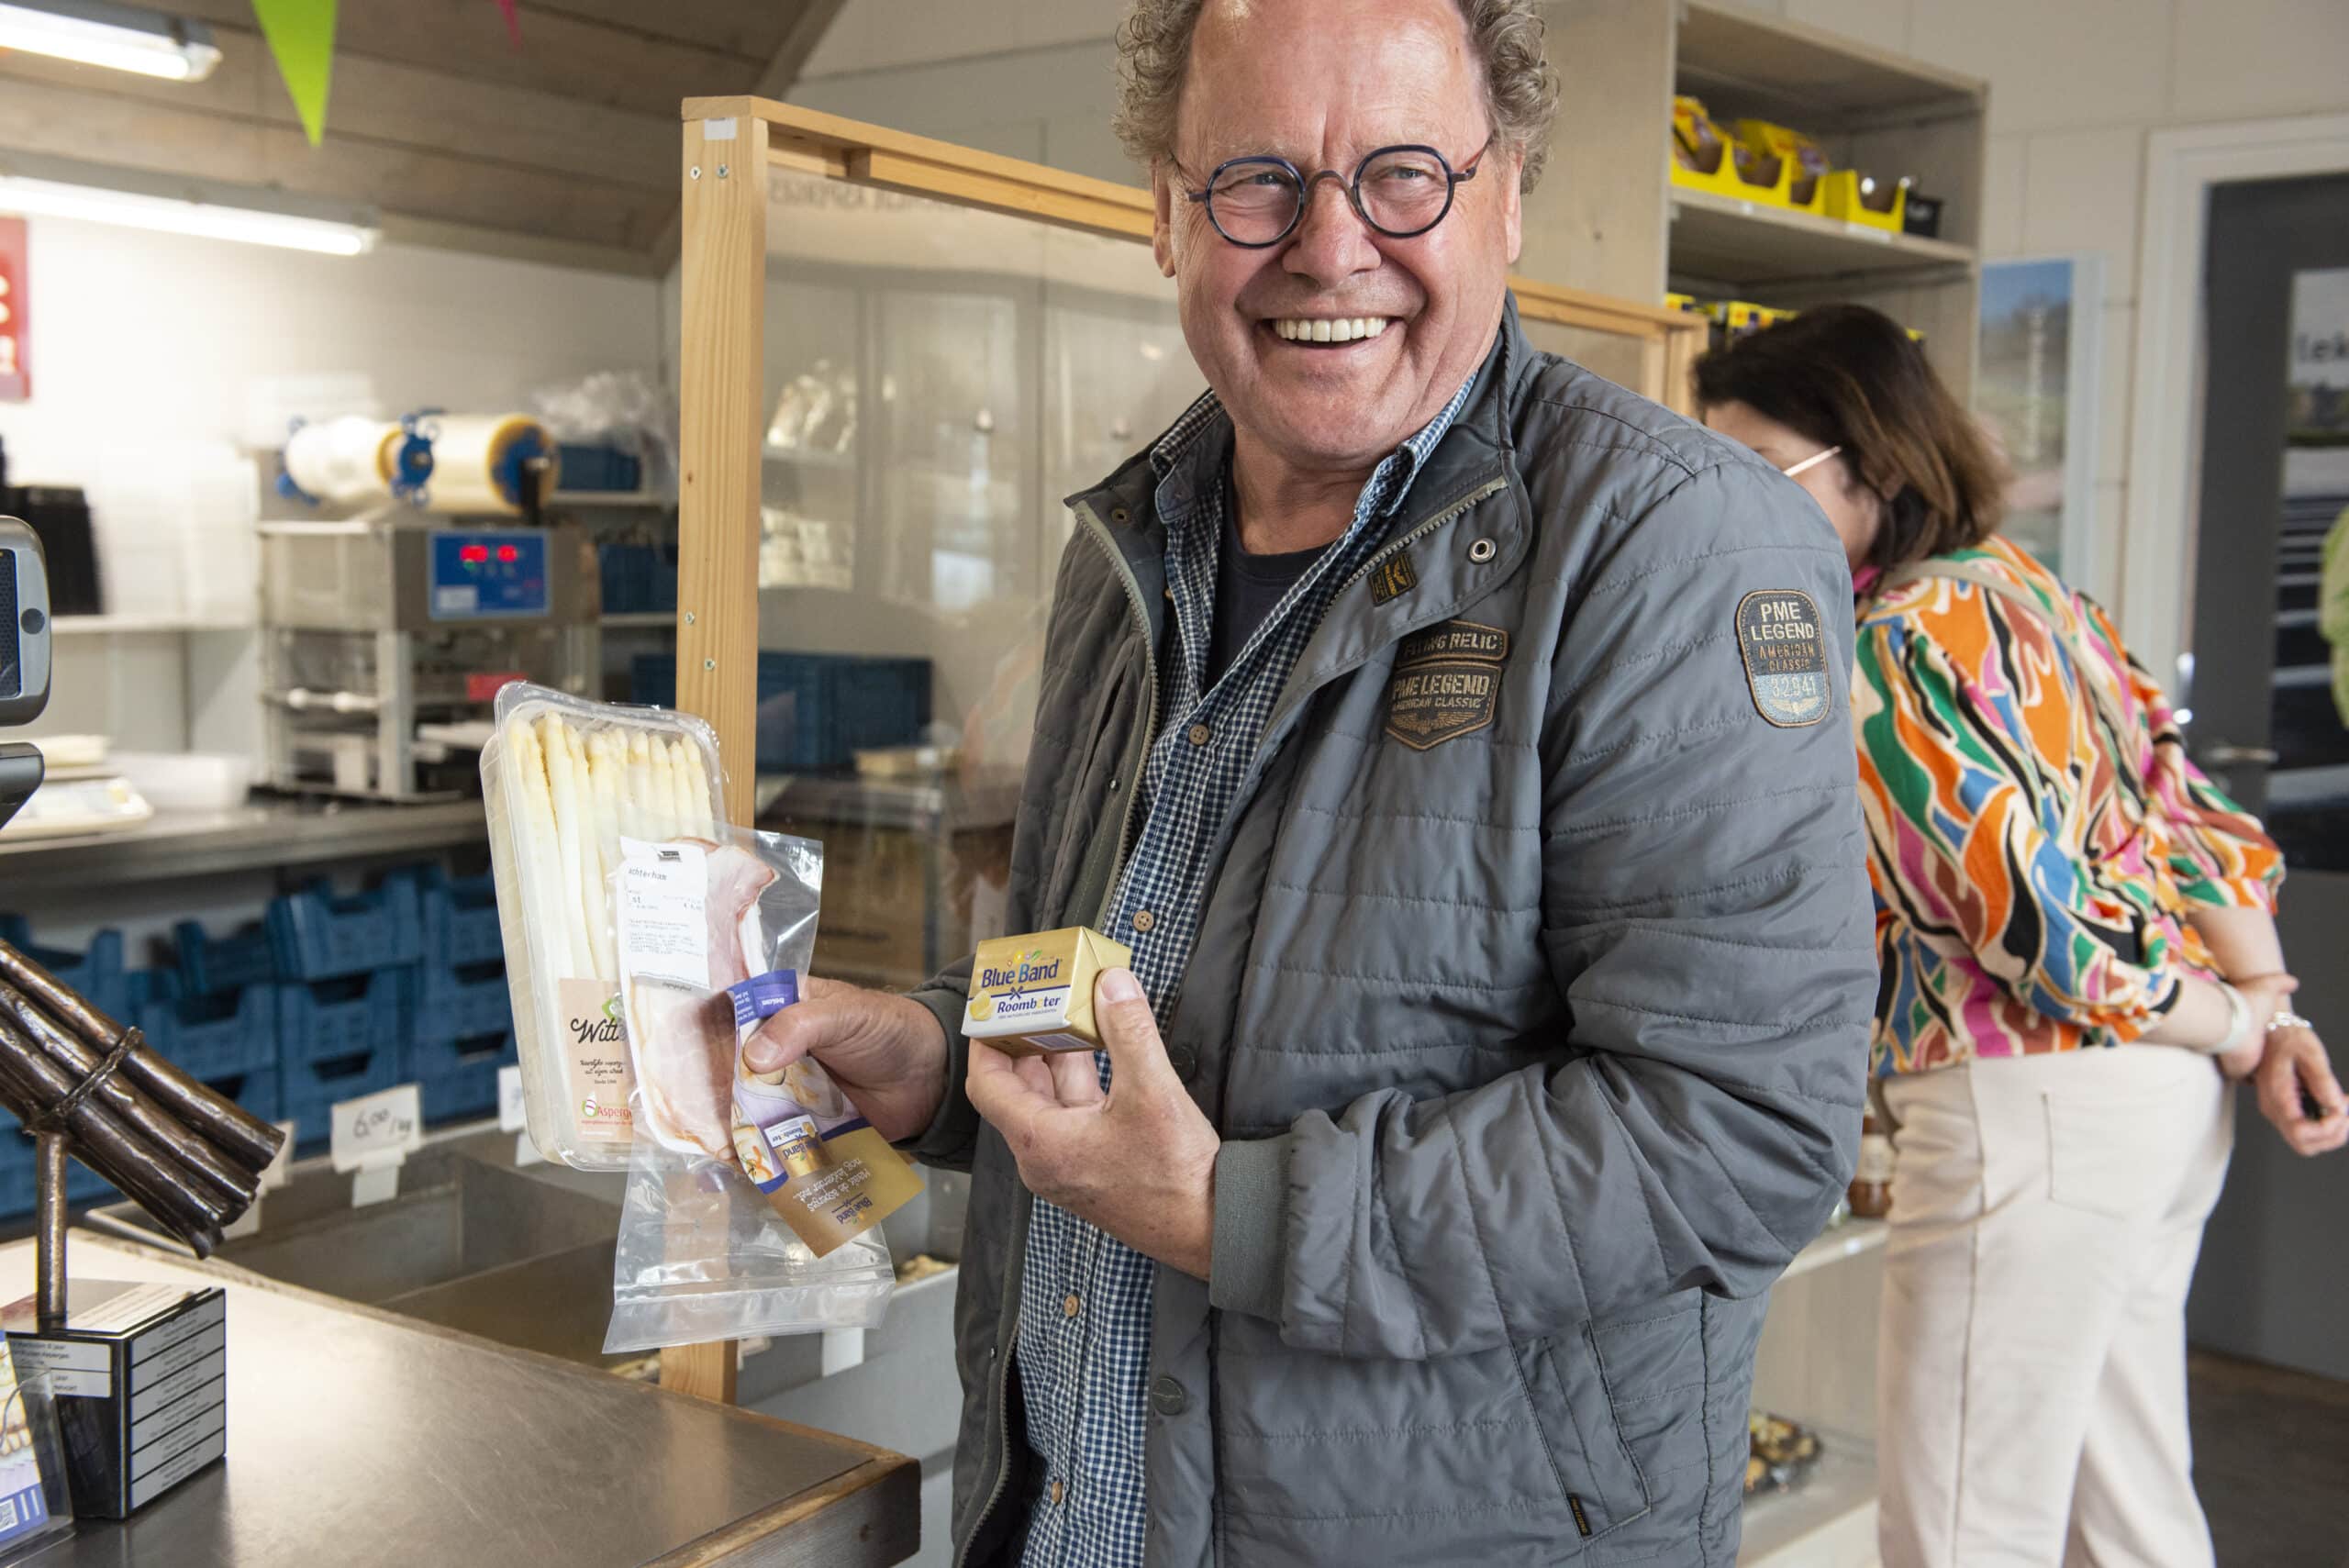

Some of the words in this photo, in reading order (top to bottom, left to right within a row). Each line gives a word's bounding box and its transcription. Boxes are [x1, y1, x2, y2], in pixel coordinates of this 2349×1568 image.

[1760, 601, 1802, 622] PME
[1751, 622, 1815, 641] LEGEND
[1449, 632, 1497, 651] RELIC
[1759, 642, 1816, 660] AMERICAN
[1768, 658, 1811, 672] CLASSIC
[1394, 674, 1421, 700] PME
[1420, 673, 1490, 696] LEGEND
[1434, 696, 1485, 708] CLASSIC
[981, 968, 1016, 988] Blue
[1018, 959, 1060, 984] Band
[853, 1195, 874, 1211] Blue
[836, 1207, 858, 1225] Band
